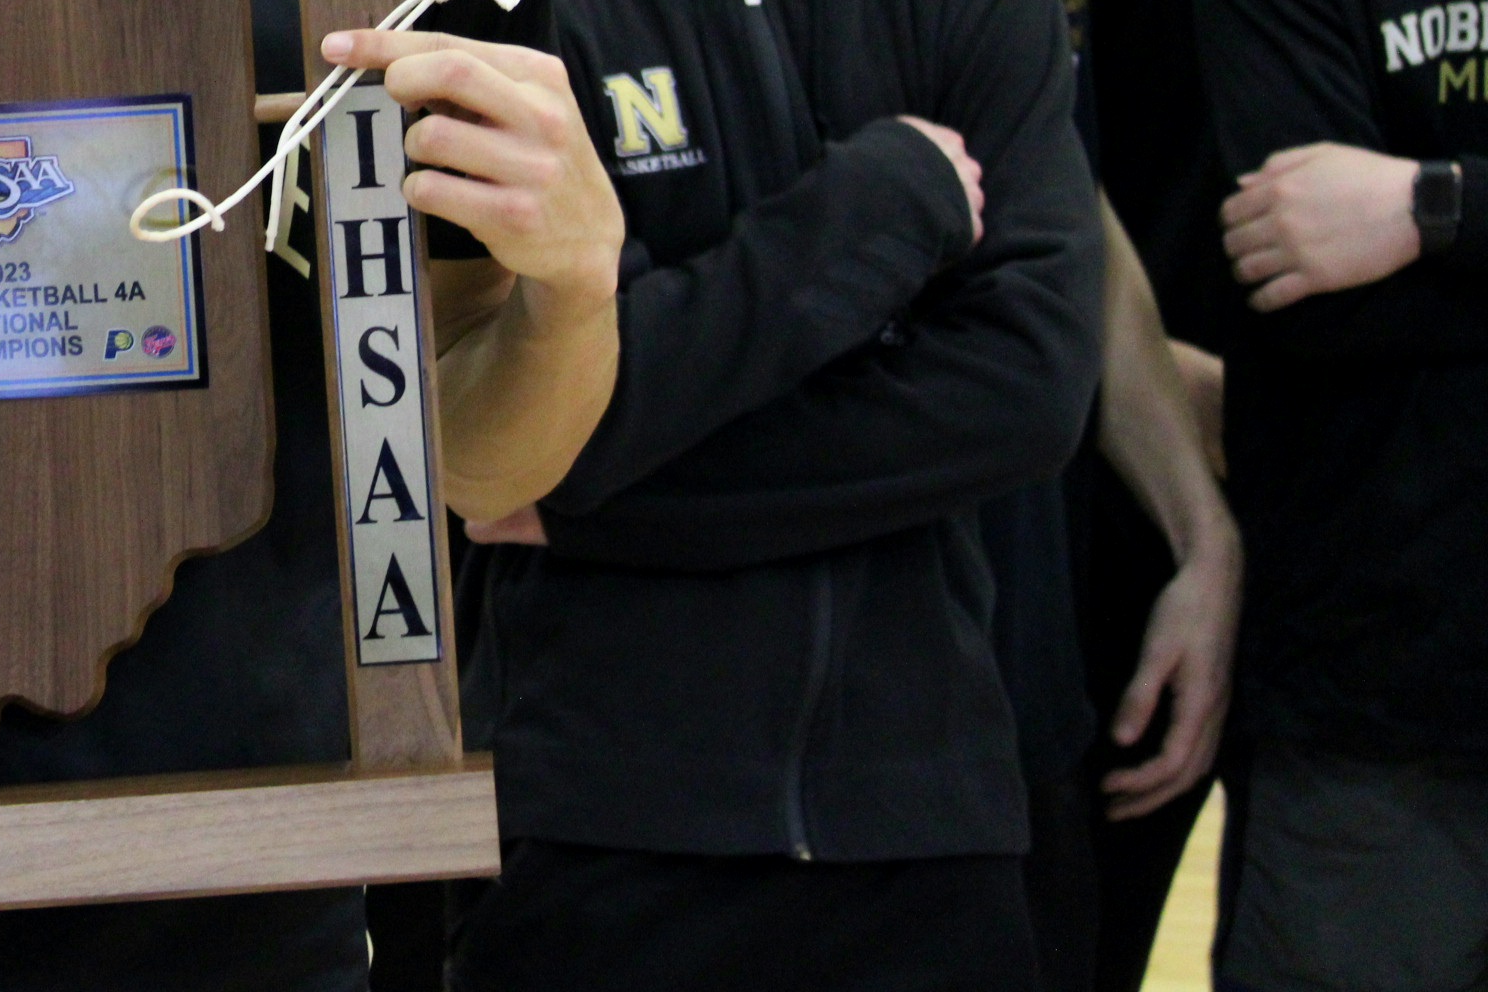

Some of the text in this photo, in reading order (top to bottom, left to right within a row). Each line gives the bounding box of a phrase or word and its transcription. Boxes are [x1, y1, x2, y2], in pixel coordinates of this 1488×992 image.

[602, 66, 689, 158] N
[608, 147, 708, 176] ASKETBALL
[114, 280, 146, 302] 4A
